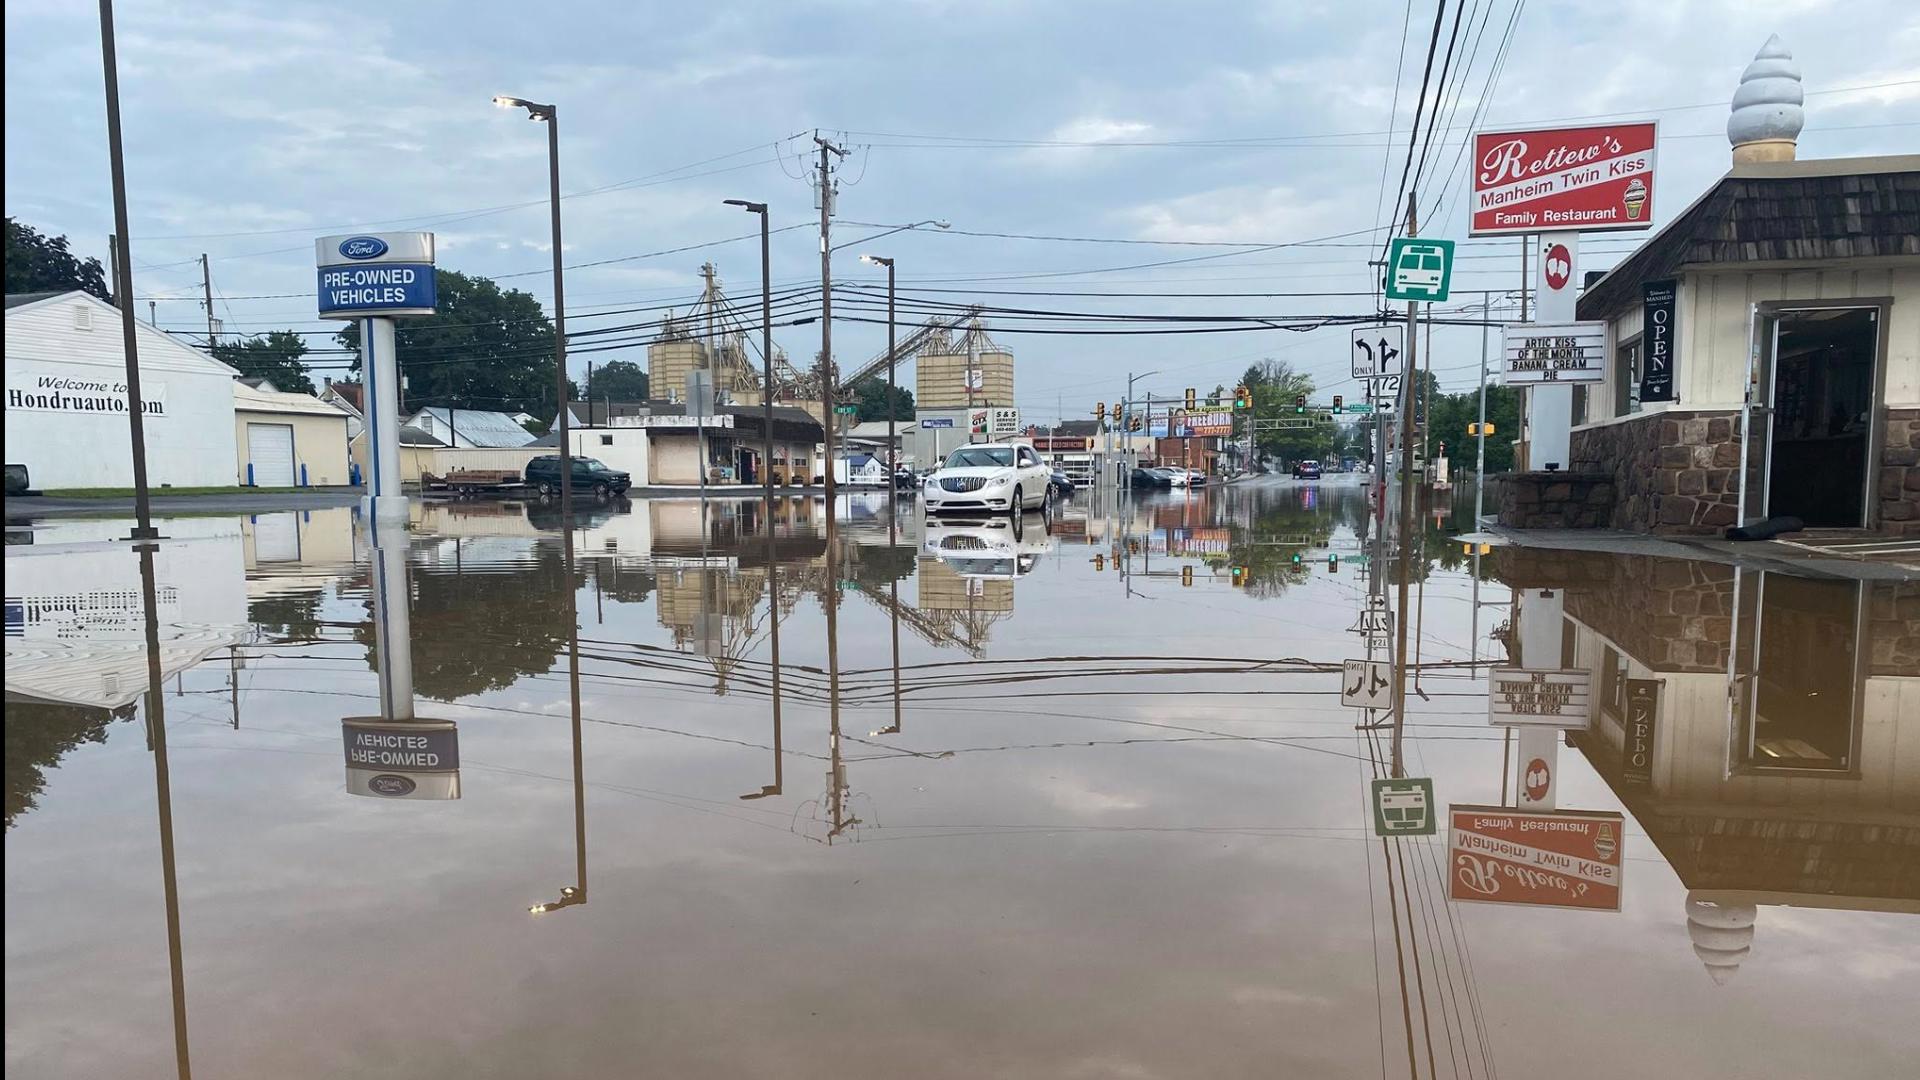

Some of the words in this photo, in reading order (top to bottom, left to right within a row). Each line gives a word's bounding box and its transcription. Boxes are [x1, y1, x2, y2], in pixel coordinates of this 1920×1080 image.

[1480, 136, 1623, 185] Rettew's
[1480, 181, 1553, 208] Manheim
[1561, 169, 1600, 188] Twin
[1609, 158, 1645, 176] Kiss
[1495, 211, 1537, 225] Family
[1544, 207, 1616, 222] Restaurant
[348, 241, 374, 255] Ford
[324, 269, 415, 288] PRE-OWNED
[331, 287, 406, 305] VEHICLES
[1525, 338, 1551, 348] ARTIC
[1555, 337, 1576, 347] KISS
[1652, 309, 1667, 371] OPEN
[1518, 350, 1529, 359] OF
[1533, 349, 1549, 358] THE
[1551, 349, 1584, 359] MONTH
[1354, 367, 1373, 375] ONLY
[1512, 360, 1547, 371] BANANA
[1553, 360, 1586, 369] CREAM
[1543, 371, 1558, 380] PIE
[38, 376, 108, 392] Welcome
[8, 389, 163, 414] Hondruauto.om
[1187, 412, 1231, 427] FREEBURN
